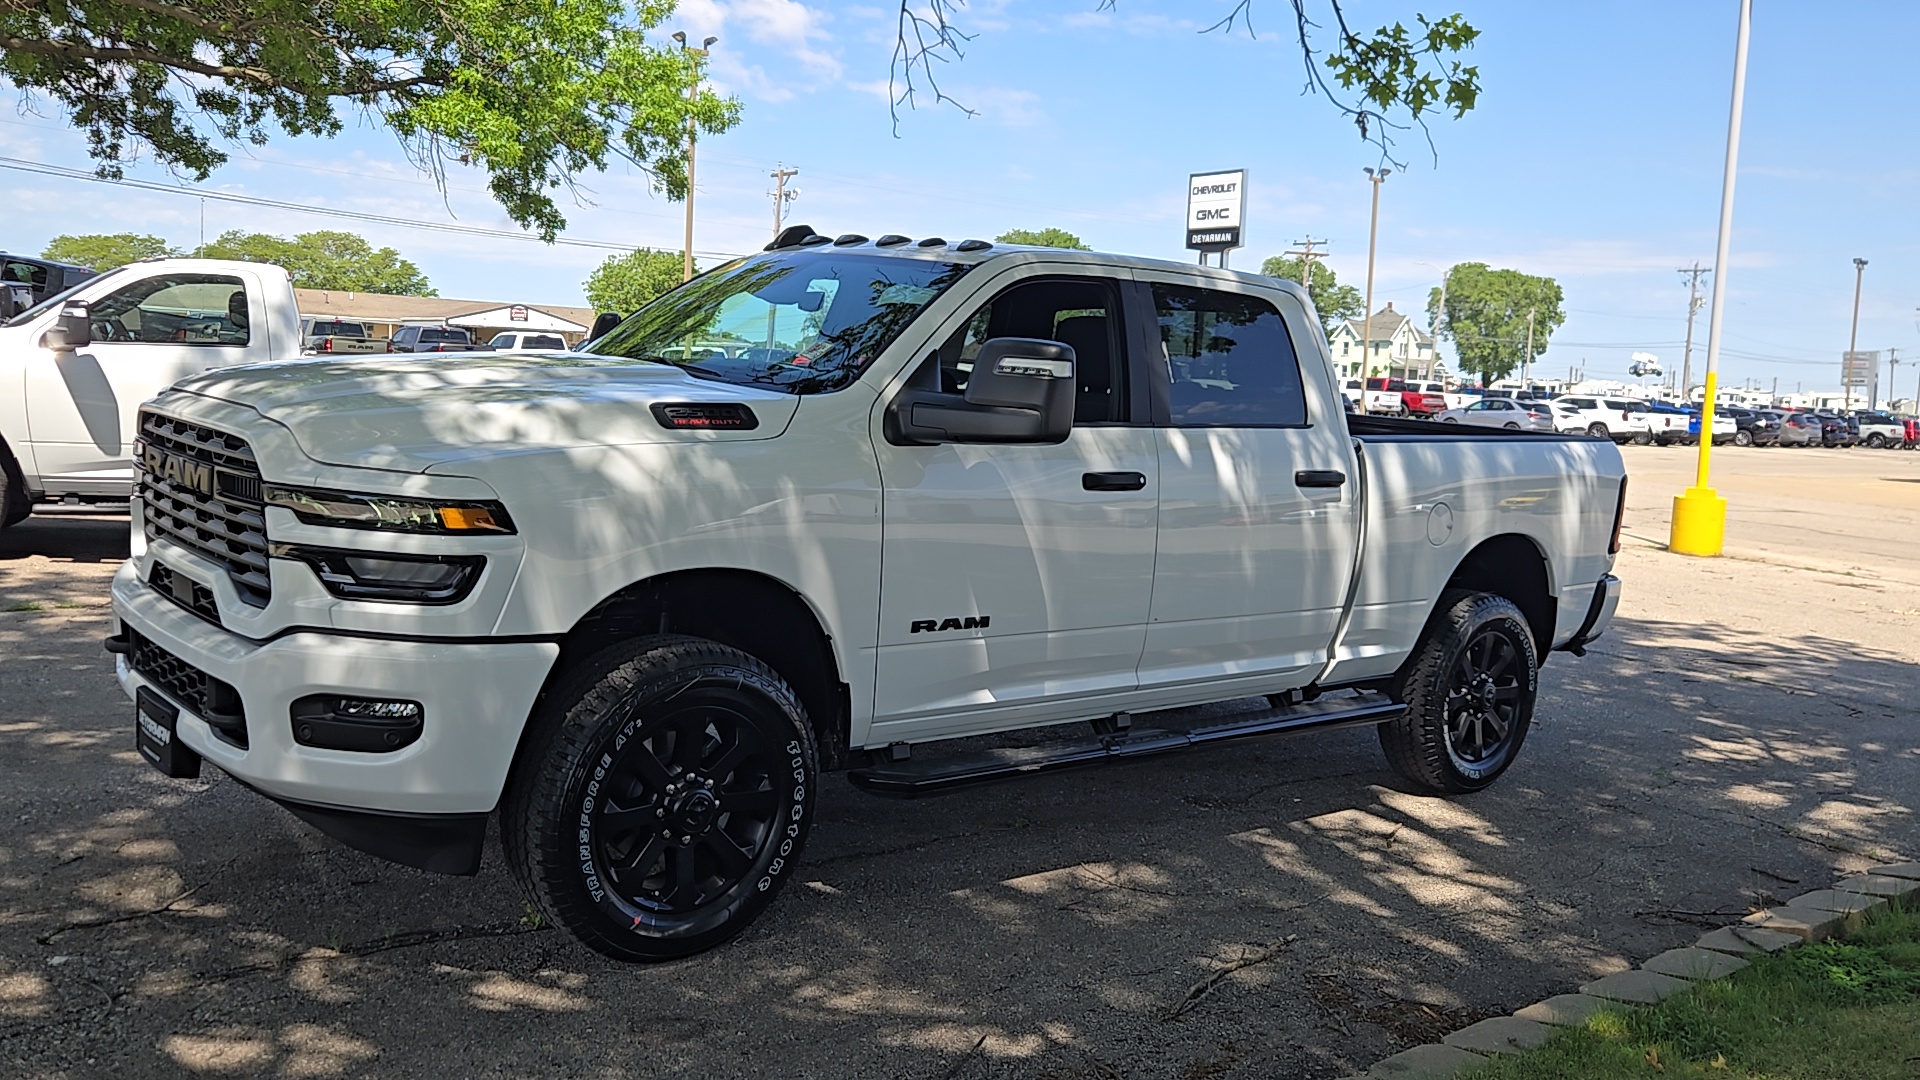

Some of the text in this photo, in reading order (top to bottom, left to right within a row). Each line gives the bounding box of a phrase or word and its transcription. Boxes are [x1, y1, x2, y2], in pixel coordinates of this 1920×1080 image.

[1192, 183, 1237, 196] CHEVROLET
[1196, 208, 1230, 220] GMC
[1191, 233, 1232, 244] DEYARMAN
[666, 407, 736, 418] 2500
[145, 445, 214, 496] RAM
[910, 616, 990, 634] RAM
[579, 753, 613, 902] TRANSFORCE
